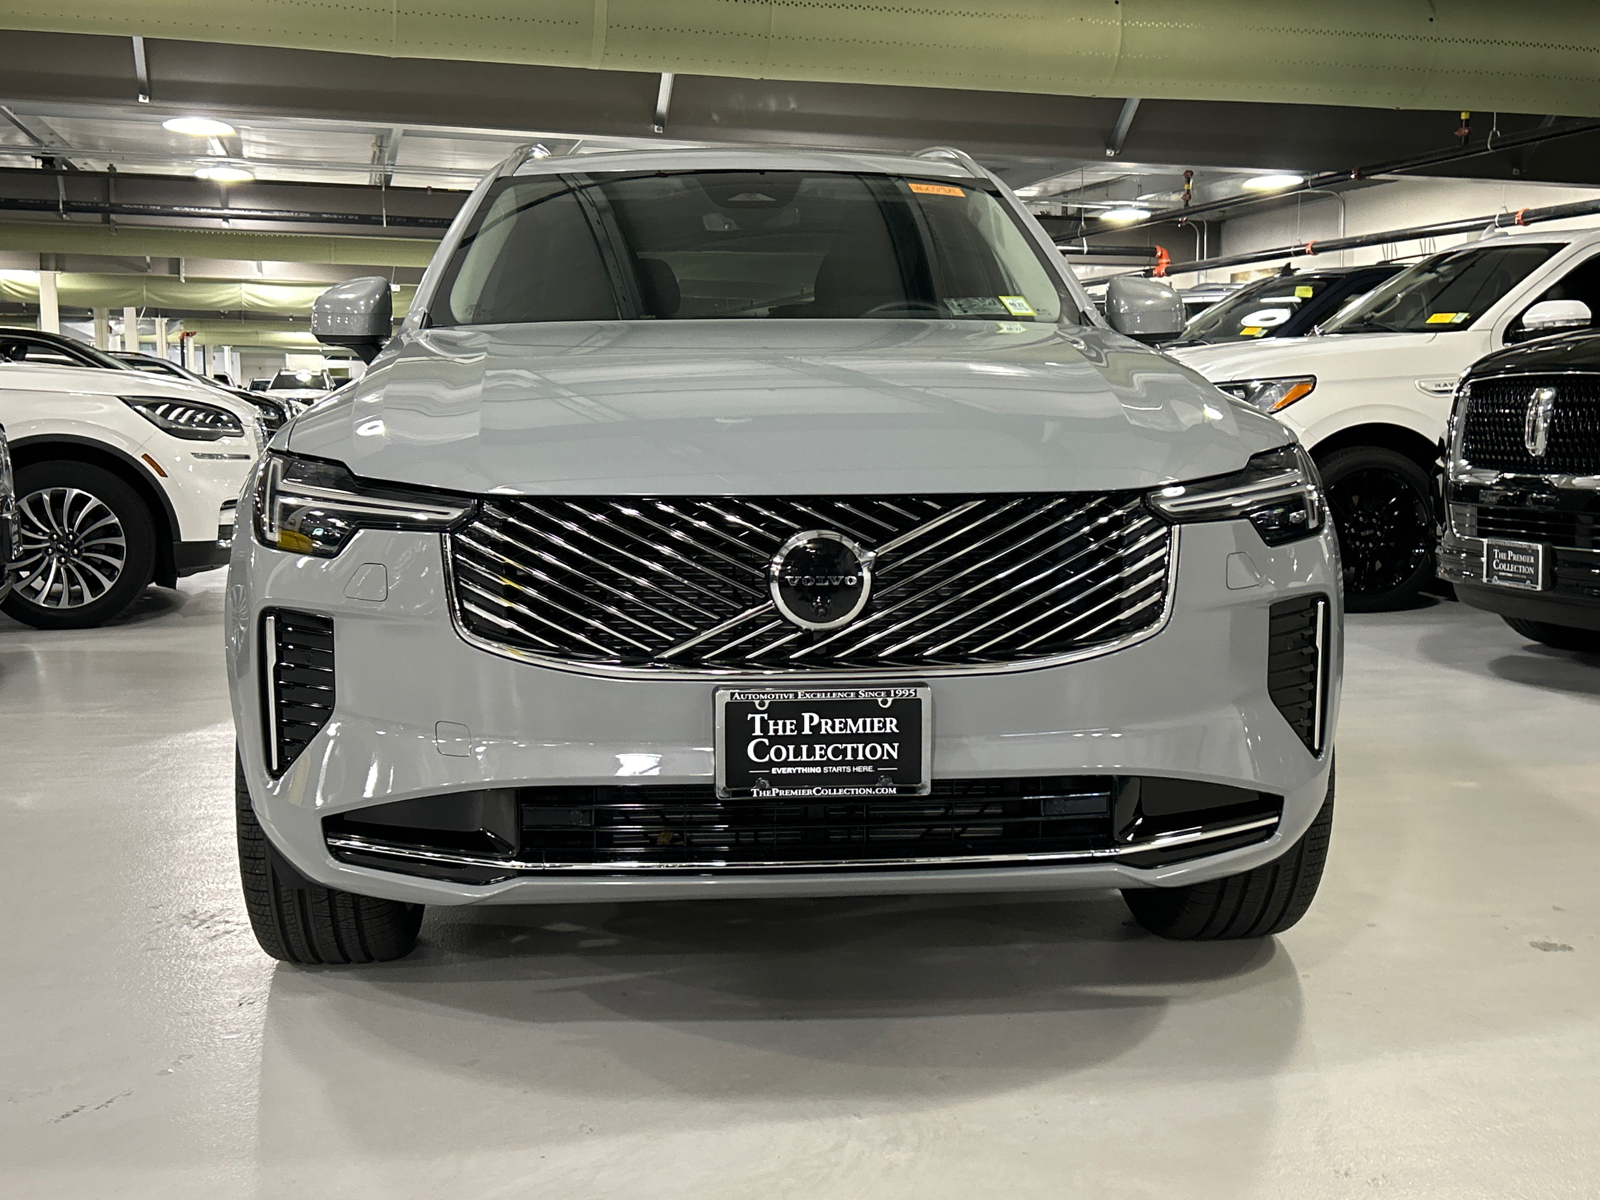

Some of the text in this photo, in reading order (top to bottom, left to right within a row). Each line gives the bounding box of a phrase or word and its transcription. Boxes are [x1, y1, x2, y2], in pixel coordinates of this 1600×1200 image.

[1493, 549, 1534, 563] THE PREMIER
[1493, 559, 1534, 574] COLLECTION
[785, 575, 857, 586] VOLVO
[732, 688, 916, 700] AUTOMOTIVE EXCELLENCE SINCE 1995
[747, 712, 899, 735] THE PREMIER
[747, 738, 899, 762] COLLECTION
[771, 766, 822, 774] EVERYTHING
